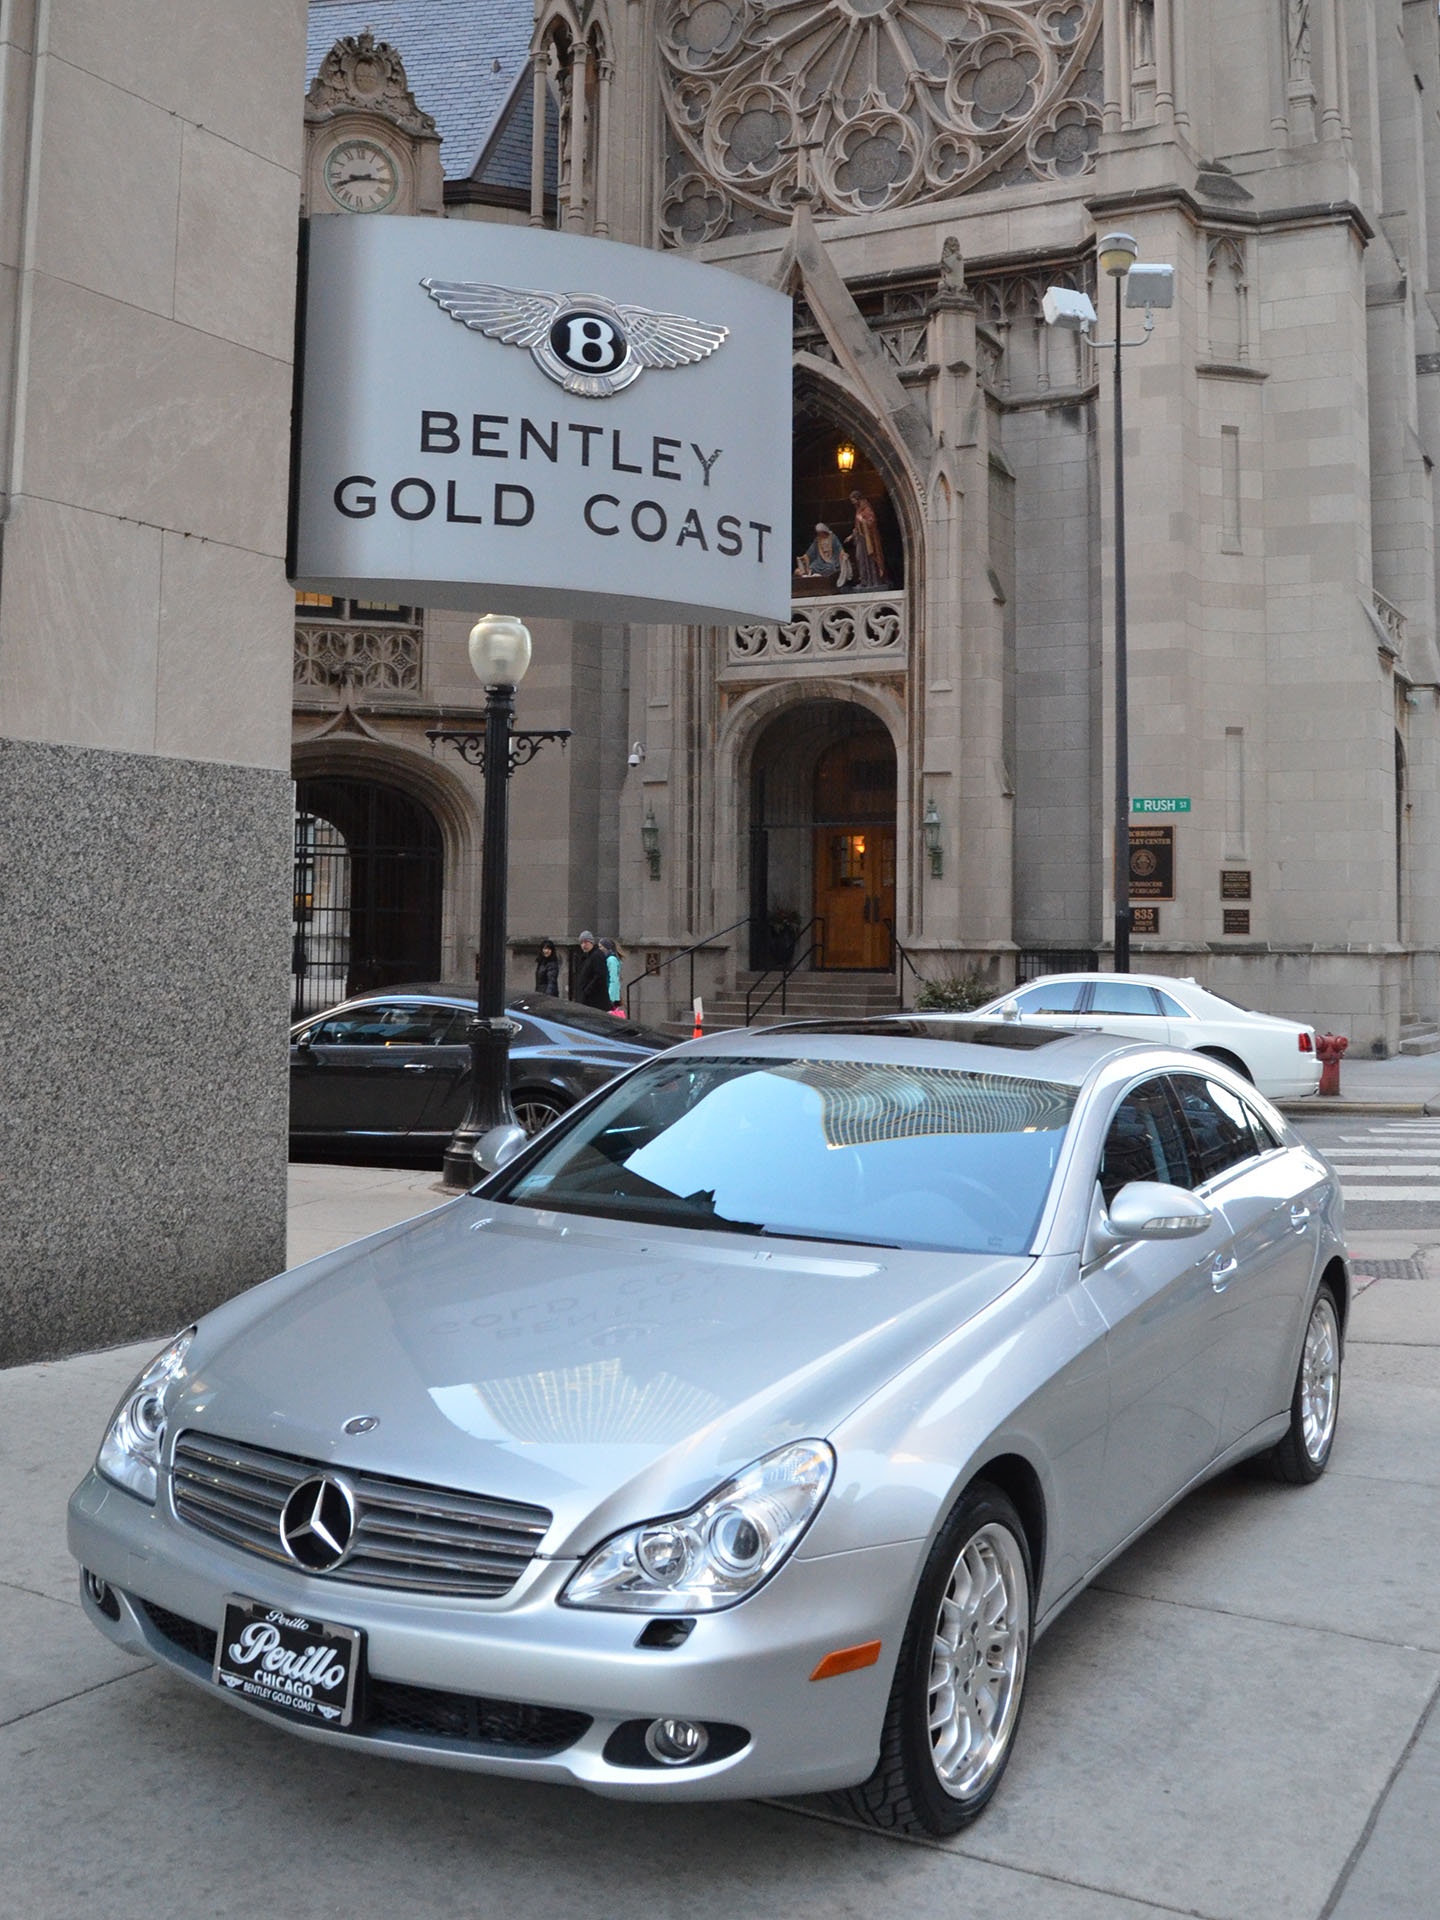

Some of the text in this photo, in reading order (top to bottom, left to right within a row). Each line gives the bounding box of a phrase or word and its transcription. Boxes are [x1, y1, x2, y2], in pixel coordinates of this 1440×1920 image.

[567, 317, 614, 368] B
[420, 409, 723, 487] BENTLEY
[333, 475, 772, 563] GOLD COAST
[1144, 799, 1176, 811] RUSH
[1134, 909, 1154, 920] 835
[265, 1610, 310, 1631] Perillo
[228, 1622, 345, 1690] Perillo
[243, 1681, 316, 1713] BENTLEY GOLD COAST
[253, 1669, 313, 1699] CHICAGO
